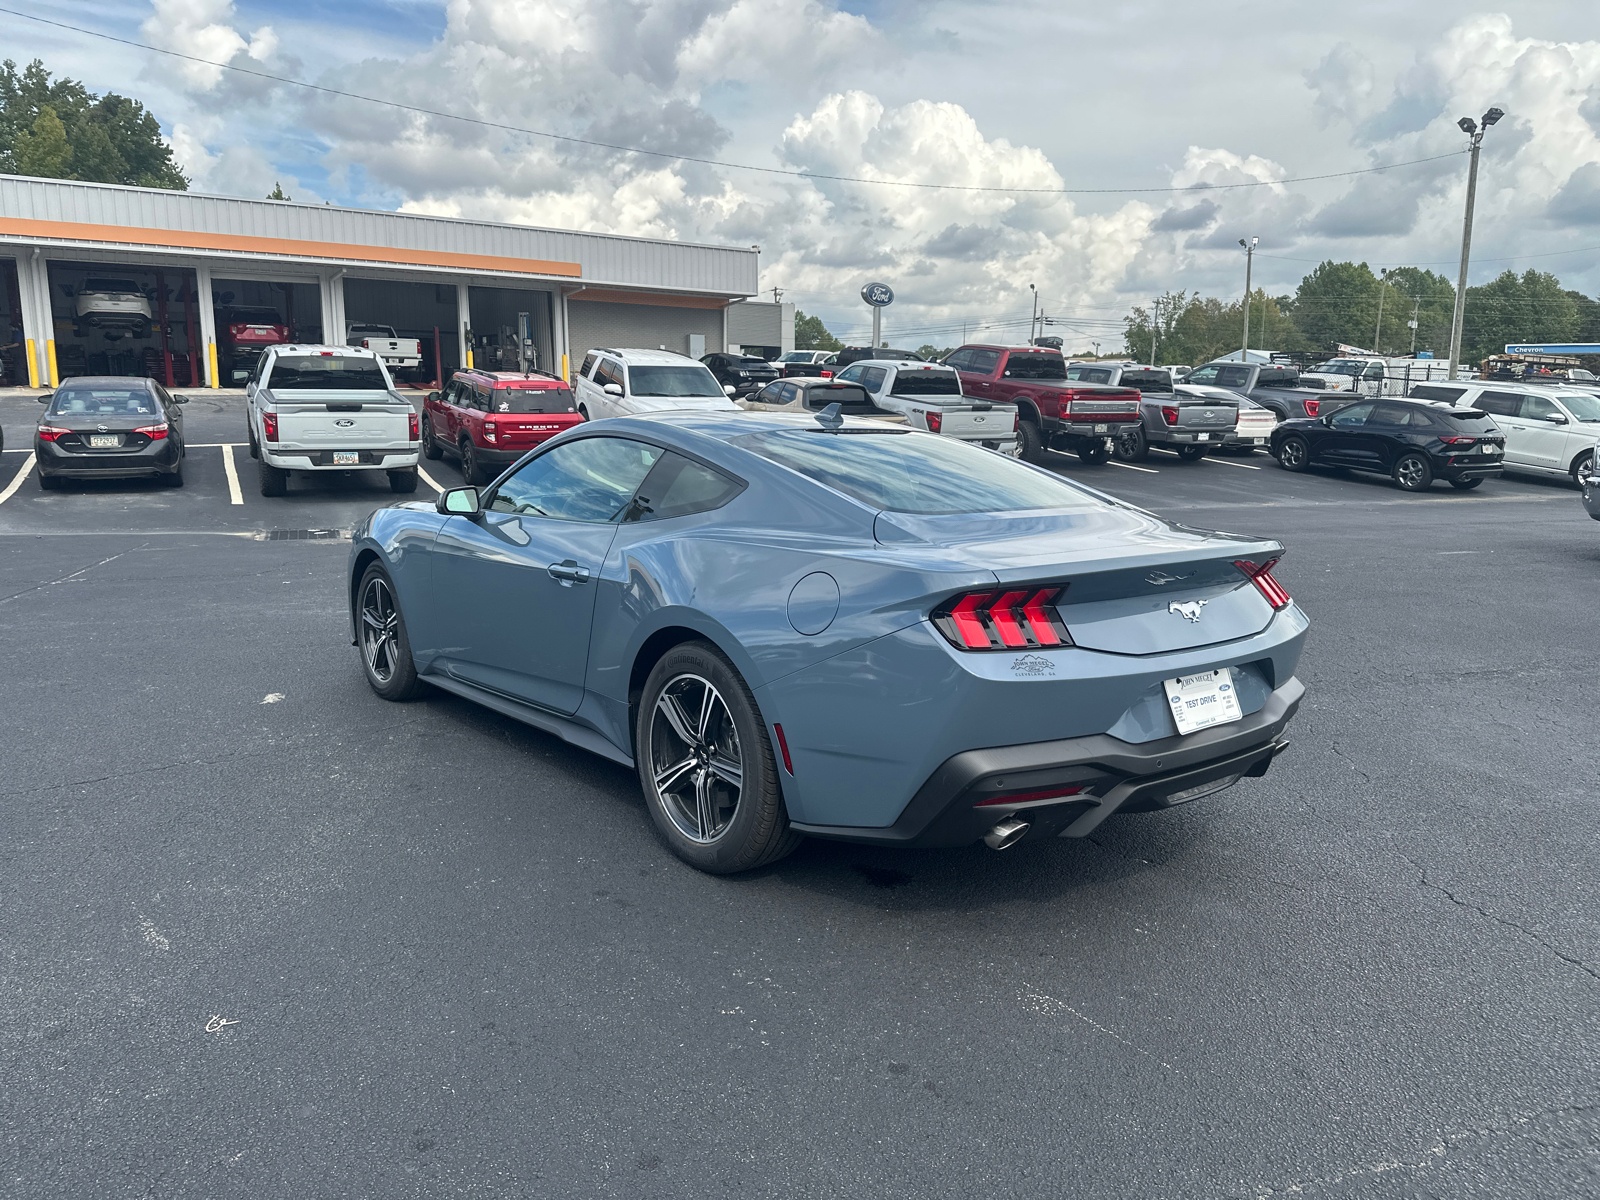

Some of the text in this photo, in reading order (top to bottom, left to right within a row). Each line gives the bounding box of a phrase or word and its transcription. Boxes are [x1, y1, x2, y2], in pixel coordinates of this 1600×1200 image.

[872, 286, 890, 302] Ford
[667, 653, 705, 668] Continental
[1181, 674, 1214, 690] JOHN MEGEL
[1185, 694, 1217, 709] TEST DRIVE
